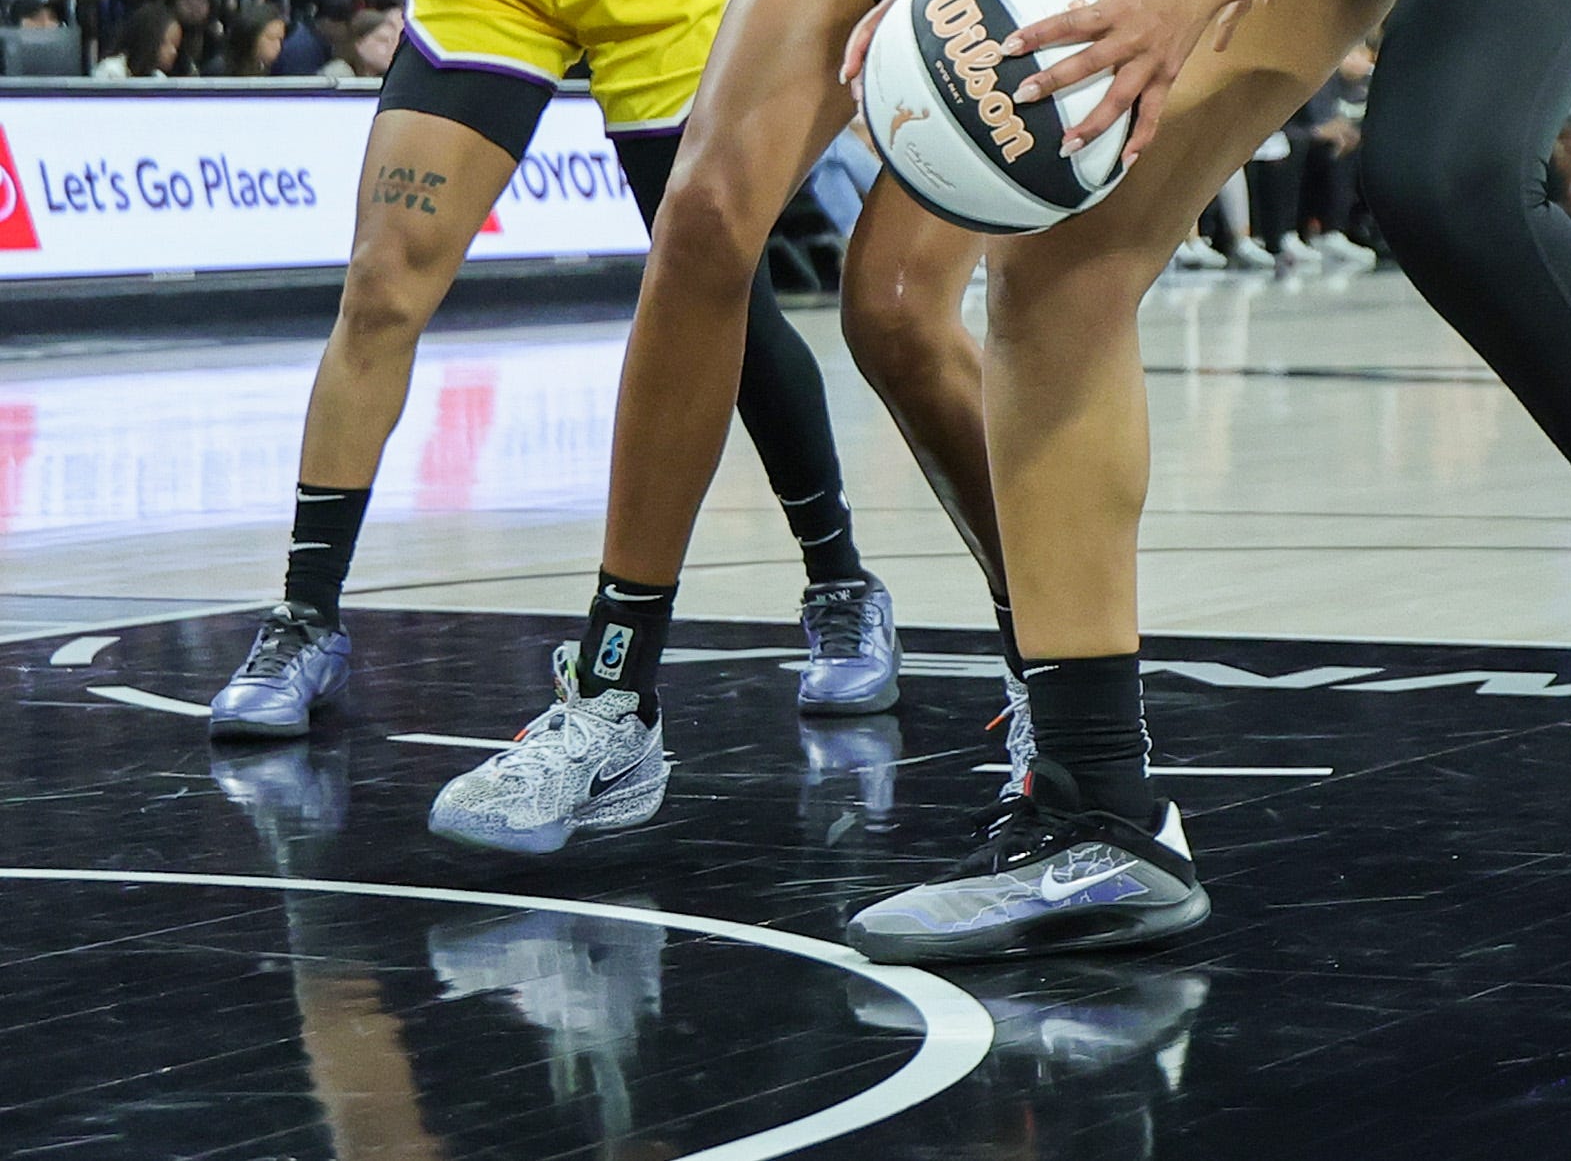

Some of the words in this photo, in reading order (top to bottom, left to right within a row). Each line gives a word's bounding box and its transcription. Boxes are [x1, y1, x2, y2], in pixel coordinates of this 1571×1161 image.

[38, 159, 130, 214] Let's
[136, 161, 194, 211] Go
[199, 153, 318, 210] Places
